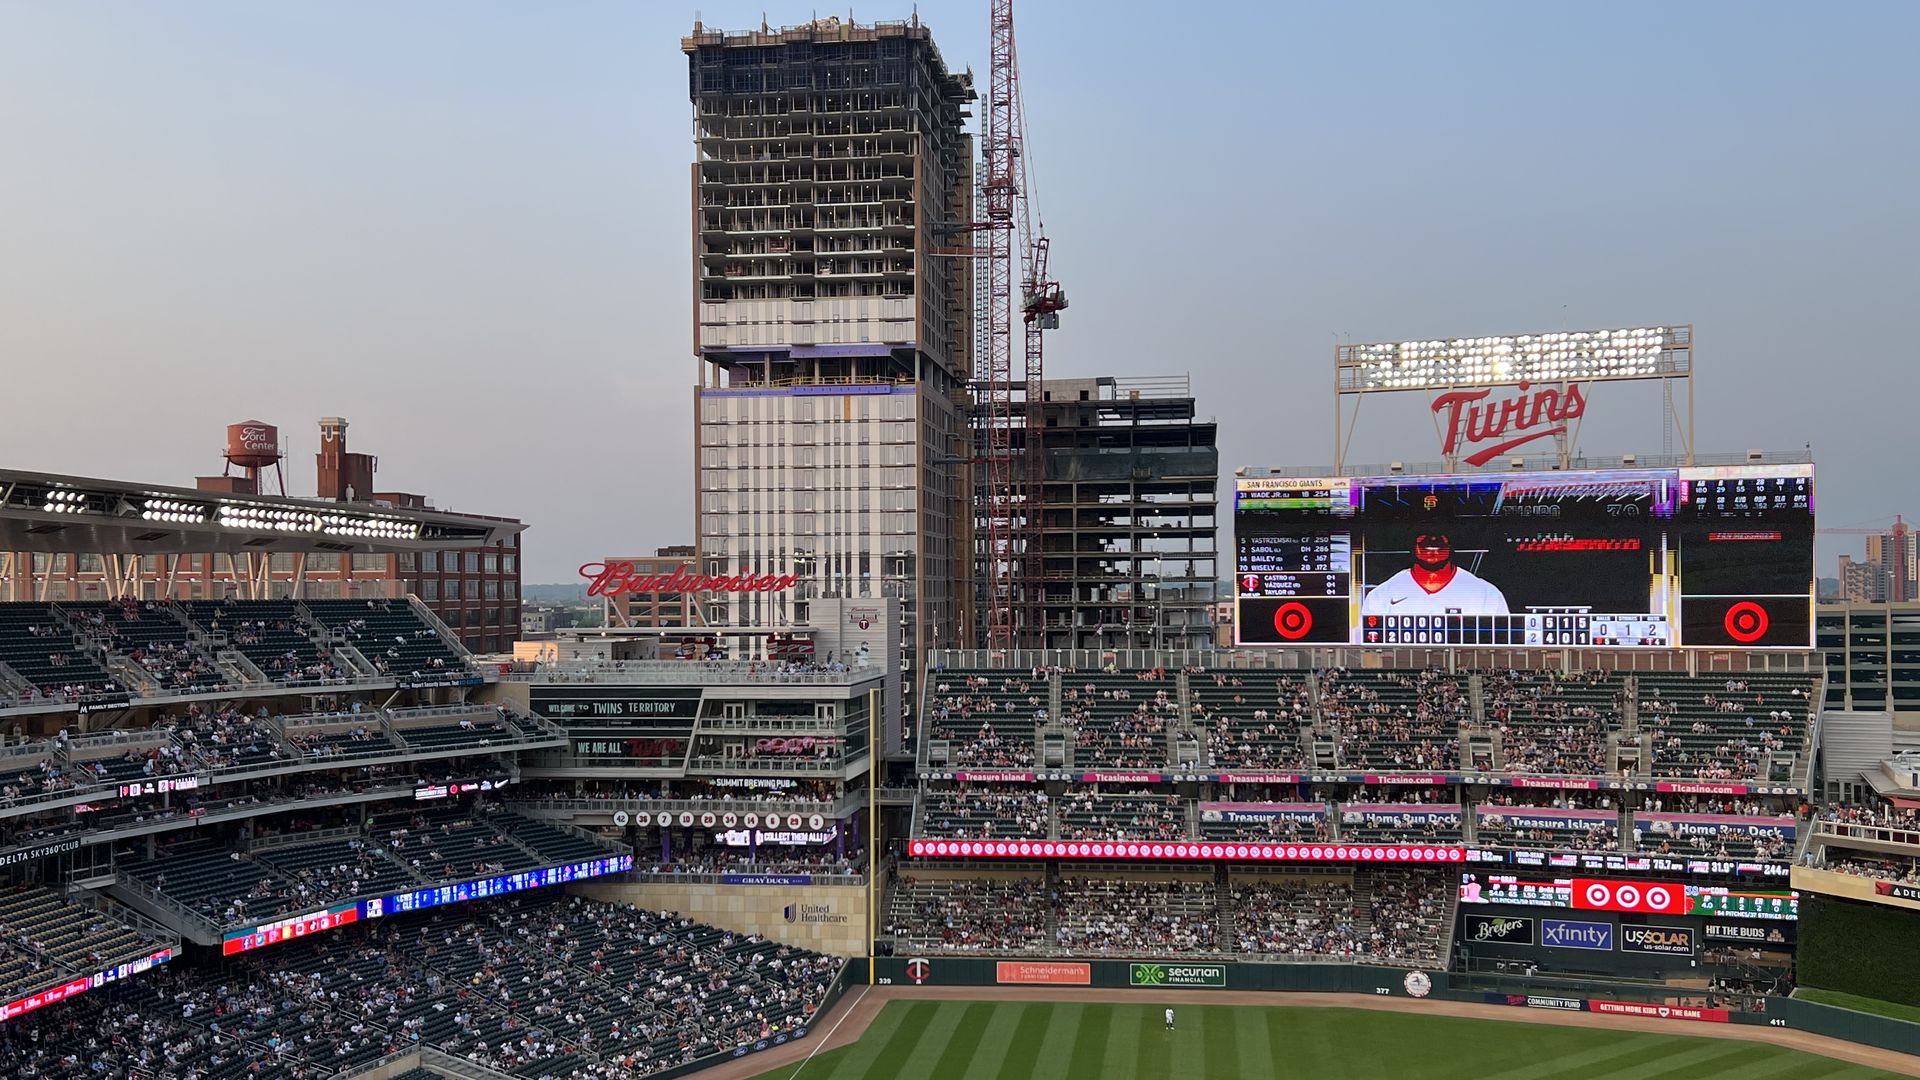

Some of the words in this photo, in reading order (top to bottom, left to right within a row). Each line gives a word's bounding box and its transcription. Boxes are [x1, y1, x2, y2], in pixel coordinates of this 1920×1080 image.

[1431, 380, 1585, 456] Twins
[240, 426, 266, 441] Ford
[244, 440, 275, 450] Center
[1262, 480, 1297, 488] FRANCISCO
[579, 560, 799, 597] Budweiser
[1388, 617, 1395, 628] 0
[1403, 617, 1410, 628] 0
[1418, 617, 1426, 628] 0
[1434, 617, 1441, 628] 0
[1530, 618, 1536, 628] 0
[1546, 617, 1553, 628] 5
[1563, 617, 1569, 628] 1
[1579, 617, 1586, 628] 5
[1600, 624, 1607, 636] 0
[1625, 624, 1630, 636] 1
[1649, 624, 1656, 636] 2
[1388, 631, 1396, 642] 2
[1404, 631, 1411, 642] 0
[1419, 631, 1427, 642] 0
[1434, 631, 1442, 642] 0
[1530, 633, 1537, 643] 2
[1546, 632, 1554, 643] 4
[1562, 632, 1570, 643] 0
[1580, 632, 1586, 643] 1
[548, 704, 575, 713] WELCOME
[593, 702, 623, 714] TWINS
[628, 702, 676, 713] TERRITORY
[578, 742, 590, 753] WE
[592, 742, 607, 753] ARE
[608, 742, 622, 753] ALL
[965, 773, 999, 781] Treasure
[1002, 773, 1026, 781] Island
[1228, 775, 1264, 783] Treasure
[1265, 775, 1291, 783] Island
[716, 779, 743, 787] SUMMIT
[744, 779, 776, 787] BREWING
[777, 779, 791, 787] PUB
[1521, 779, 1561, 788] Treasure
[1562, 780, 1589, 789] Island
[616, 815, 626, 823] 42
[662, 815, 667, 823] 7
[683, 815, 690, 823] 10
[747, 816, 755, 824] 14
[1511, 817, 1562, 829] Treasure
[1679, 823, 1716, 835] Home
[1749, 826, 1781, 837] Deck
[764, 832, 791, 841] COLLECT
[0, 852, 28, 866] DELTA
[61, 840, 79, 852] CLUB
[1653, 859, 1671, 870] 75.7
[1764, 865, 1781, 875] 244
[801, 904, 830, 913] United
[801, 914, 847, 923] Healthcare
[1475, 919, 1523, 940] Breyers
[1706, 925, 1720, 935] HIT
[1722, 926, 1738, 936] THE
[1740, 927, 1764, 938] BUDS
[1546, 924, 1608, 947] xfinity
[1020, 966, 1084, 976] Schneiderman's
[1168, 967, 1219, 977] securian
[1527, 998, 1564, 1007] COMMUNITY
[1564, 1000, 1581, 1008] FUND
[1600, 1003, 1624, 1012] GETTING
[1625, 1005, 1642, 1013] MORE
[1683, 1009, 1701, 1018] GAME
[1770, 1018, 1785, 1026] 411
